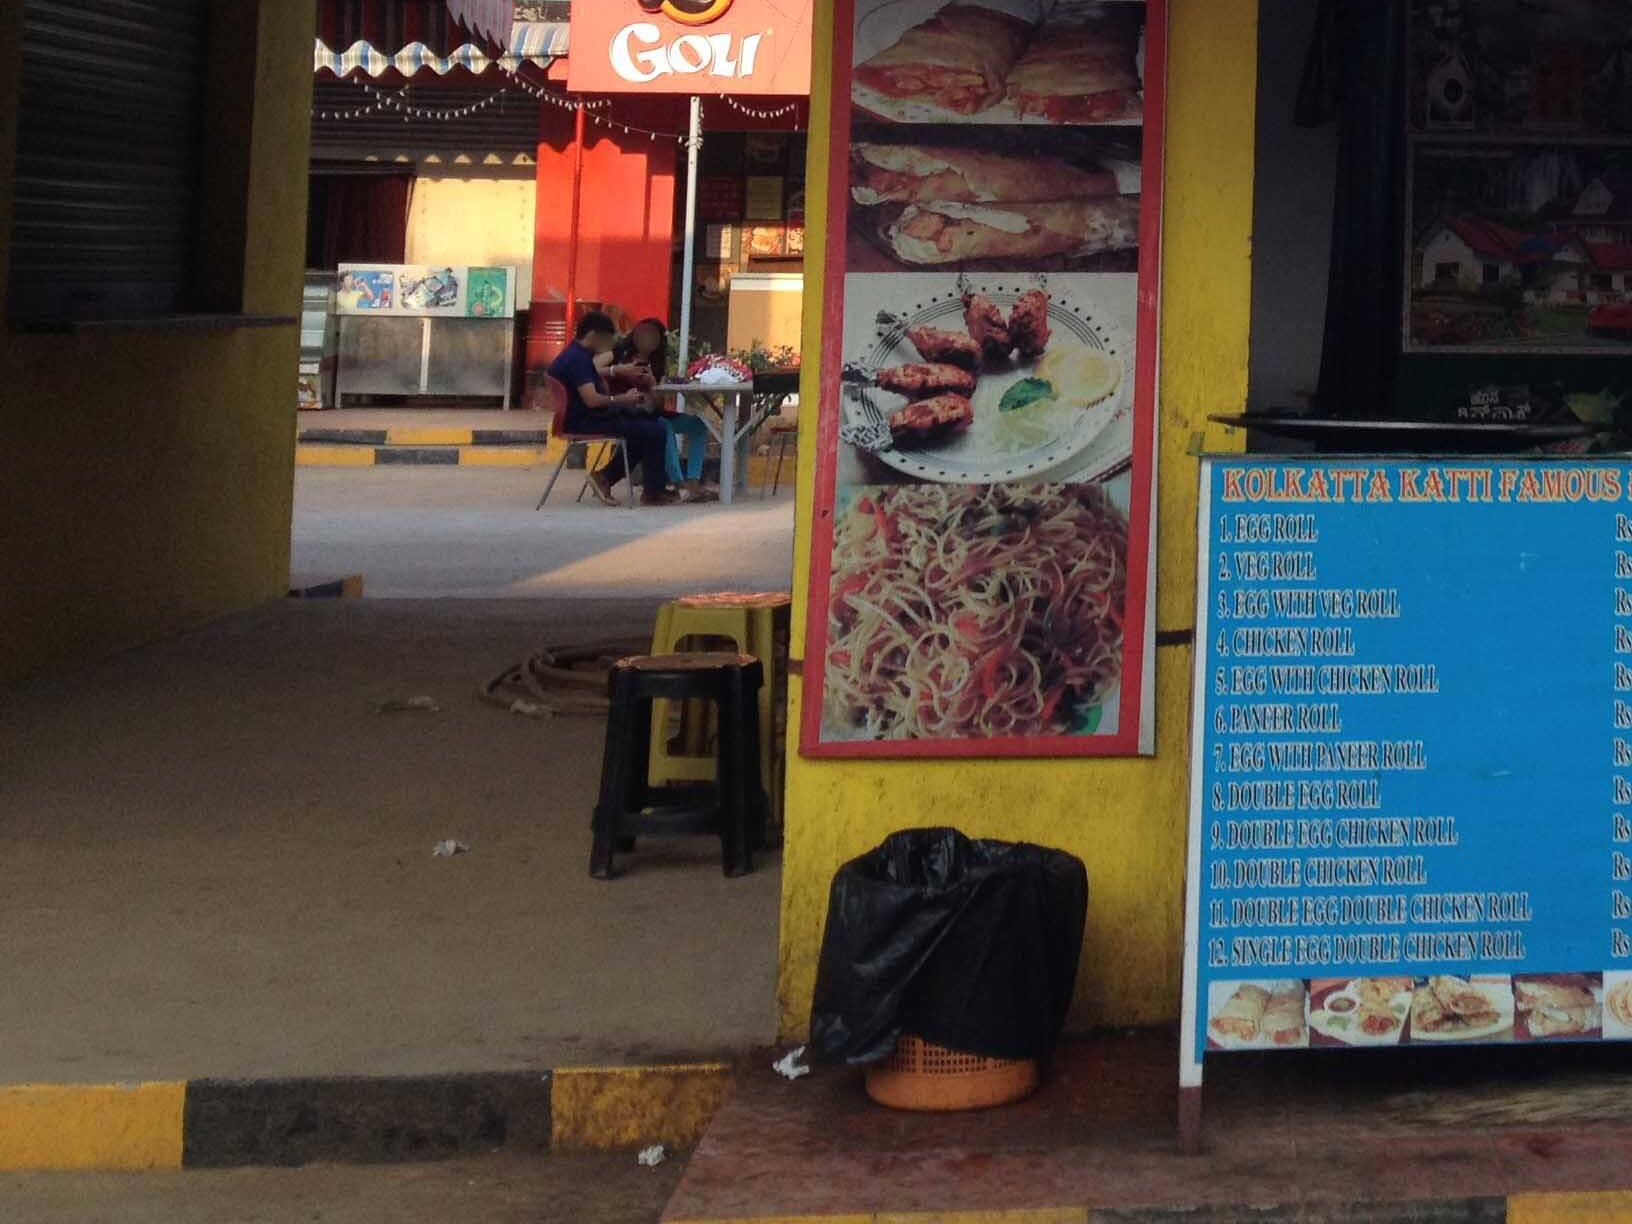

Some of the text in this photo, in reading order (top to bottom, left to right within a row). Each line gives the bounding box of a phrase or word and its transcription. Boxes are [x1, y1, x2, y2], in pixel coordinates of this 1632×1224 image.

[1222, 467, 1392, 503] KOLKATTA
[1399, 467, 1491, 503] KATTI
[1498, 468, 1621, 503] FAMOUS
[1235, 515, 1270, 543] EGG
[1272, 514, 1318, 542] ROLL
[1234, 552, 1268, 580] VEG
[1271, 551, 1317, 580] ROLL
[1233, 590, 1270, 619] EGG
[1272, 590, 1316, 619] WITH
[1319, 589, 1352, 618] VEG
[1355, 589, 1400, 618] ROLL
[1232, 628, 1309, 657] CHICKEN
[1310, 627, 1355, 656] ROLL
[1231, 666, 1267, 695] EGG
[1269, 665, 1315, 694] WITH
[1317, 665, 1392, 694] CHICKEN
[1394, 664, 1439, 693] ROLL
[1229, 705, 1294, 734] PANEER
[1296, 704, 1342, 732] ROLL
[1229, 744, 1265, 772] EGG
[1267, 743, 1312, 771] WITH
[1315, 742, 1379, 771] PANEER
[1381, 740, 1427, 770] ROLL
[1227, 781, 1295, 811] DOUBLE
[1297, 780, 1333, 810] EGG
[1335, 779, 1381, 809] ROLL
[1227, 821, 1294, 850] DOUBLE
[1297, 819, 1333, 848] EGG
[1336, 818, 1411, 848] CHICKEN
[1412, 816, 1459, 846] ROLL
[1233, 859, 1301, 888] DOUBLE
[1304, 857, 1379, 887] CHICKEN
[1382, 855, 1427, 885] ROLL
[1231, 898, 1299, 927] DOUBLE
[1301, 897, 1337, 926] EGG
[1340, 896, 1407, 925] DOUBLE
[1410, 894, 1486, 923] CHICKEN
[1487, 892, 1532, 921] ROLL
[1231, 936, 1291, 966] SINGLE
[1294, 935, 1331, 965] EGG
[1333, 934, 1400, 964] DOUBLE
[1403, 932, 1480, 963] CHICKEN
[1481, 930, 1526, 961] ROLL
